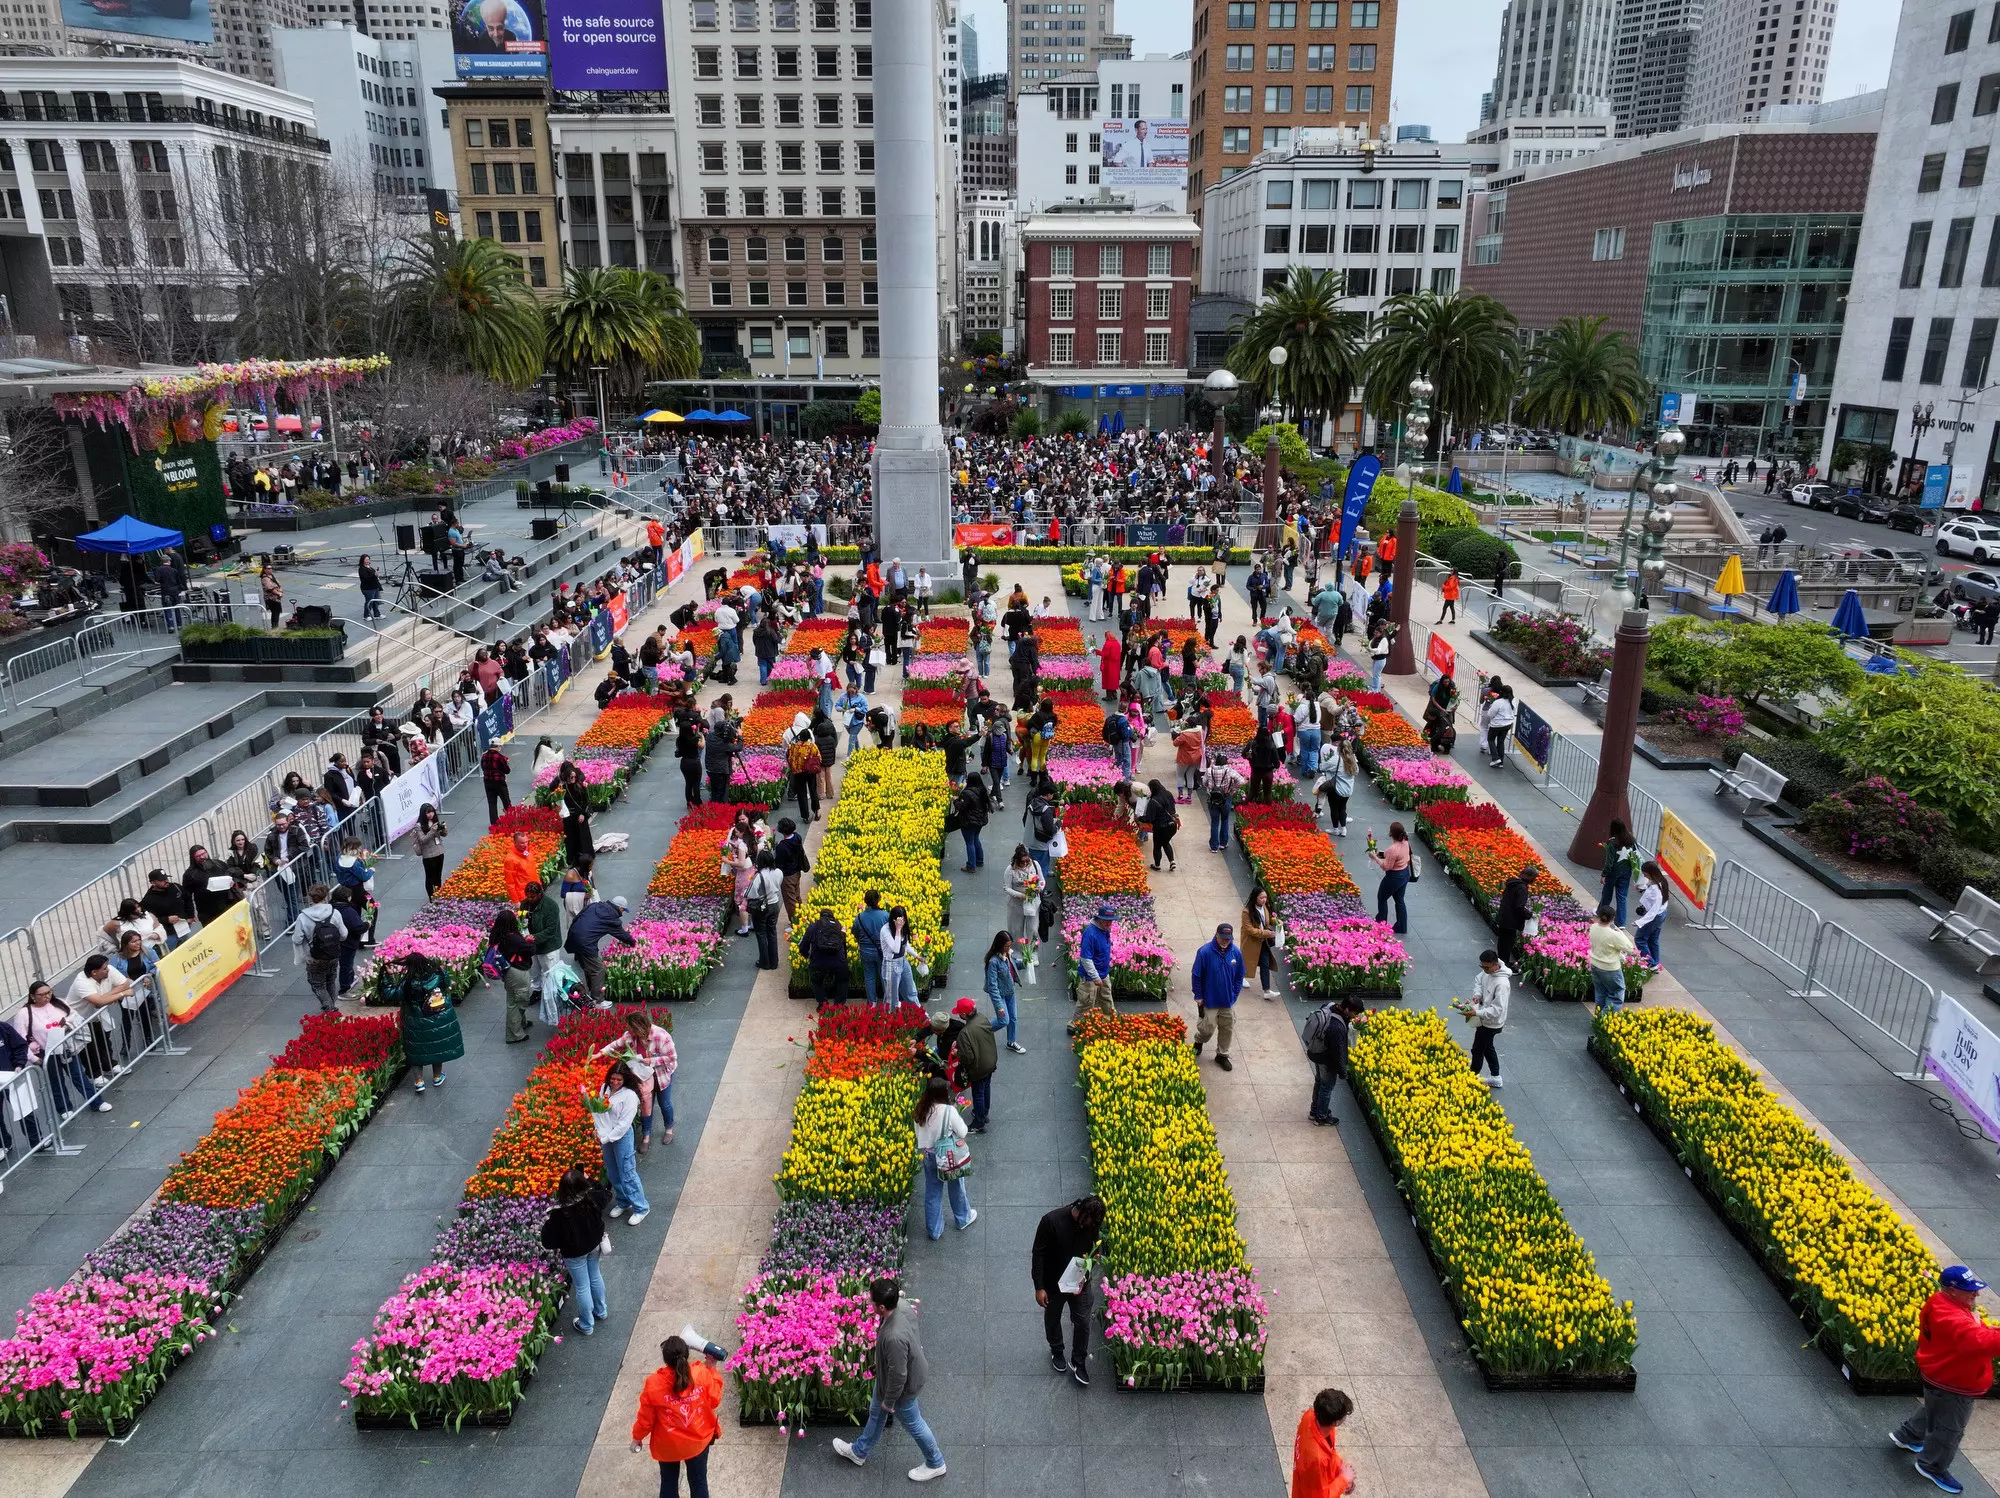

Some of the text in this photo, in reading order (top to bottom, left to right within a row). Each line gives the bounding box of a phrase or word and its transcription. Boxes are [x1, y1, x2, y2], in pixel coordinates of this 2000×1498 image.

[562, 16, 655, 28] the safe source
[563, 32, 657, 45] for open source
[586, 67, 639, 75] chainguard.dev
[1939, 419, 1975, 433] VUITON
[162, 458, 194, 470] UNION SQUARE
[170, 467, 197, 482] BLOOM
[1346, 466, 1375, 518] EXIT
[398, 787, 413, 802] Tulip
[1668, 827, 1684, 851] Events
[181, 946, 214, 974] Events
[1955, 1027, 1978, 1061] Tulip
[1953, 1043, 1973, 1072] Day
